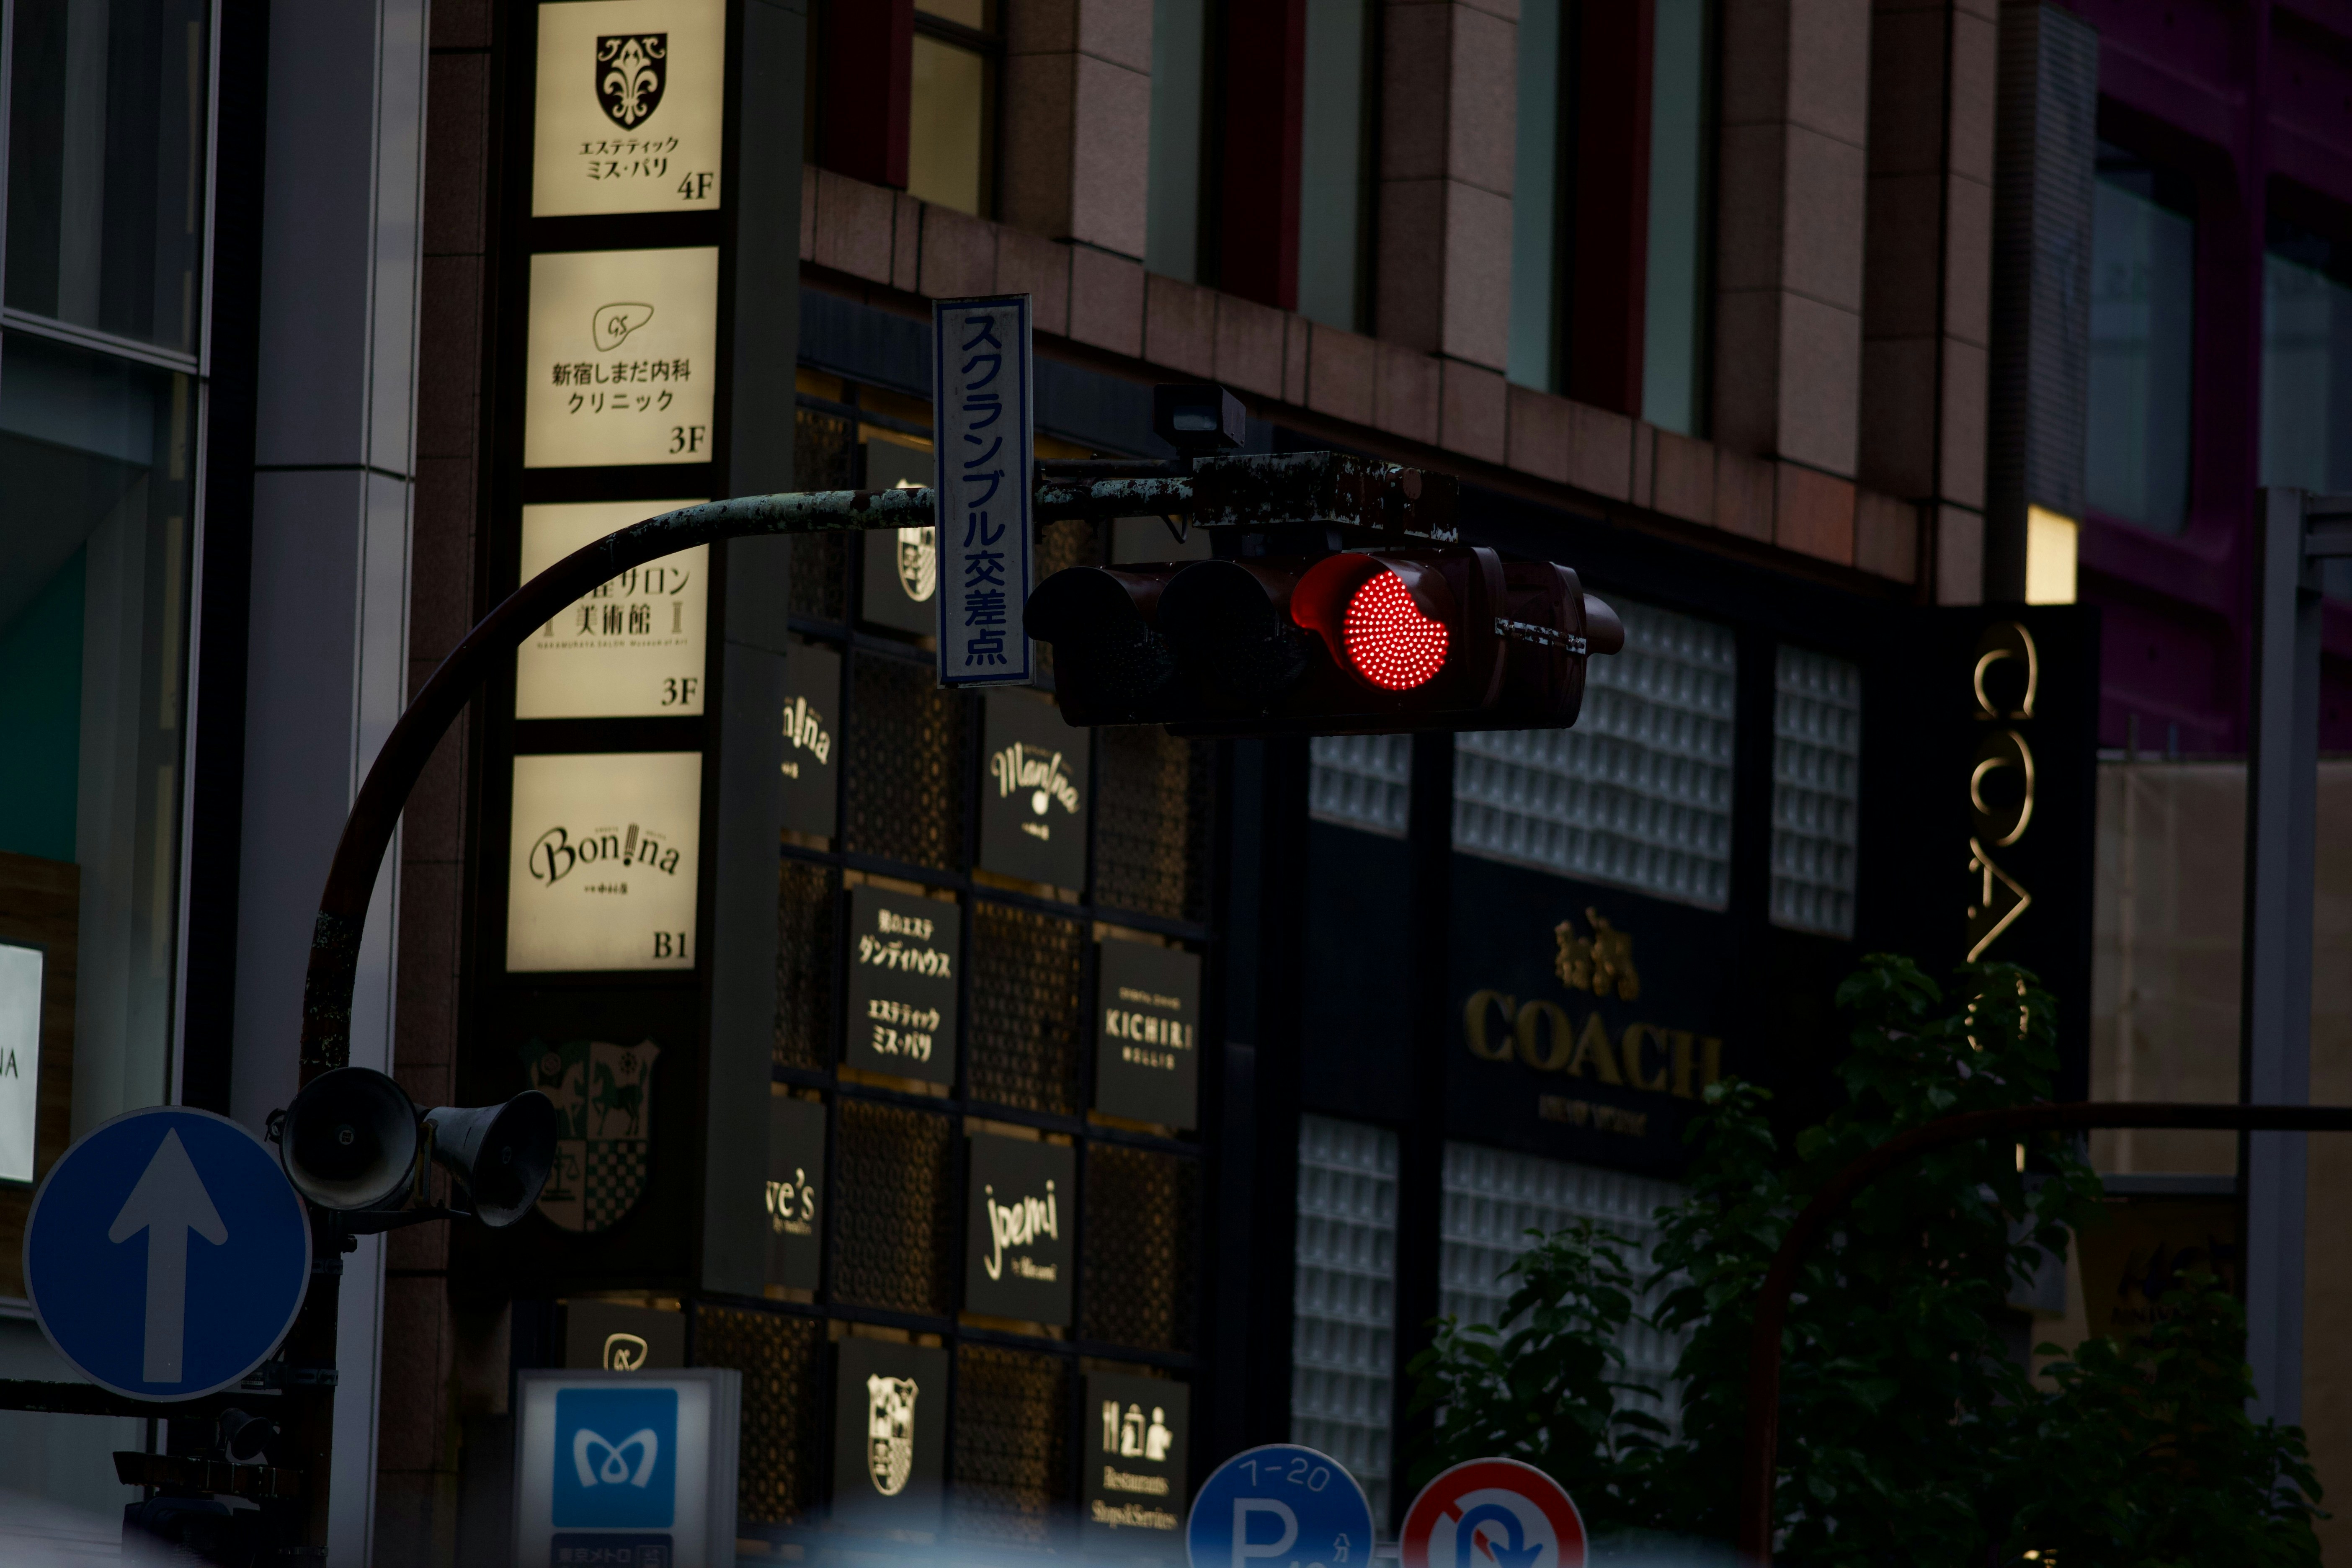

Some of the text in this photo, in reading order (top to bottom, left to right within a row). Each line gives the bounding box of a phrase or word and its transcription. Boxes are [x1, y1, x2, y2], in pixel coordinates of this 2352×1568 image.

[580, 136, 679, 155] エステティック
[586, 157, 668, 180] ミス・パリ
[677, 172, 714, 200] 4F
[552, 358, 691, 386] 新宿しまだ内科
[568, 389, 674, 415] クリニック
[669, 426, 706, 454] 3F
[962, 316, 1007, 665] スクランブル交差点
[576, 603, 650, 636] 美術館
[662, 677, 698, 706] 3F
[1963, 620, 2042, 1173] COA
[652, 931, 688, 959] B1
[1105, 1008, 1193, 1052] KICHIRI
[1462, 988, 1725, 1104] COACH
[1230, 1497, 1299, 1568] P
